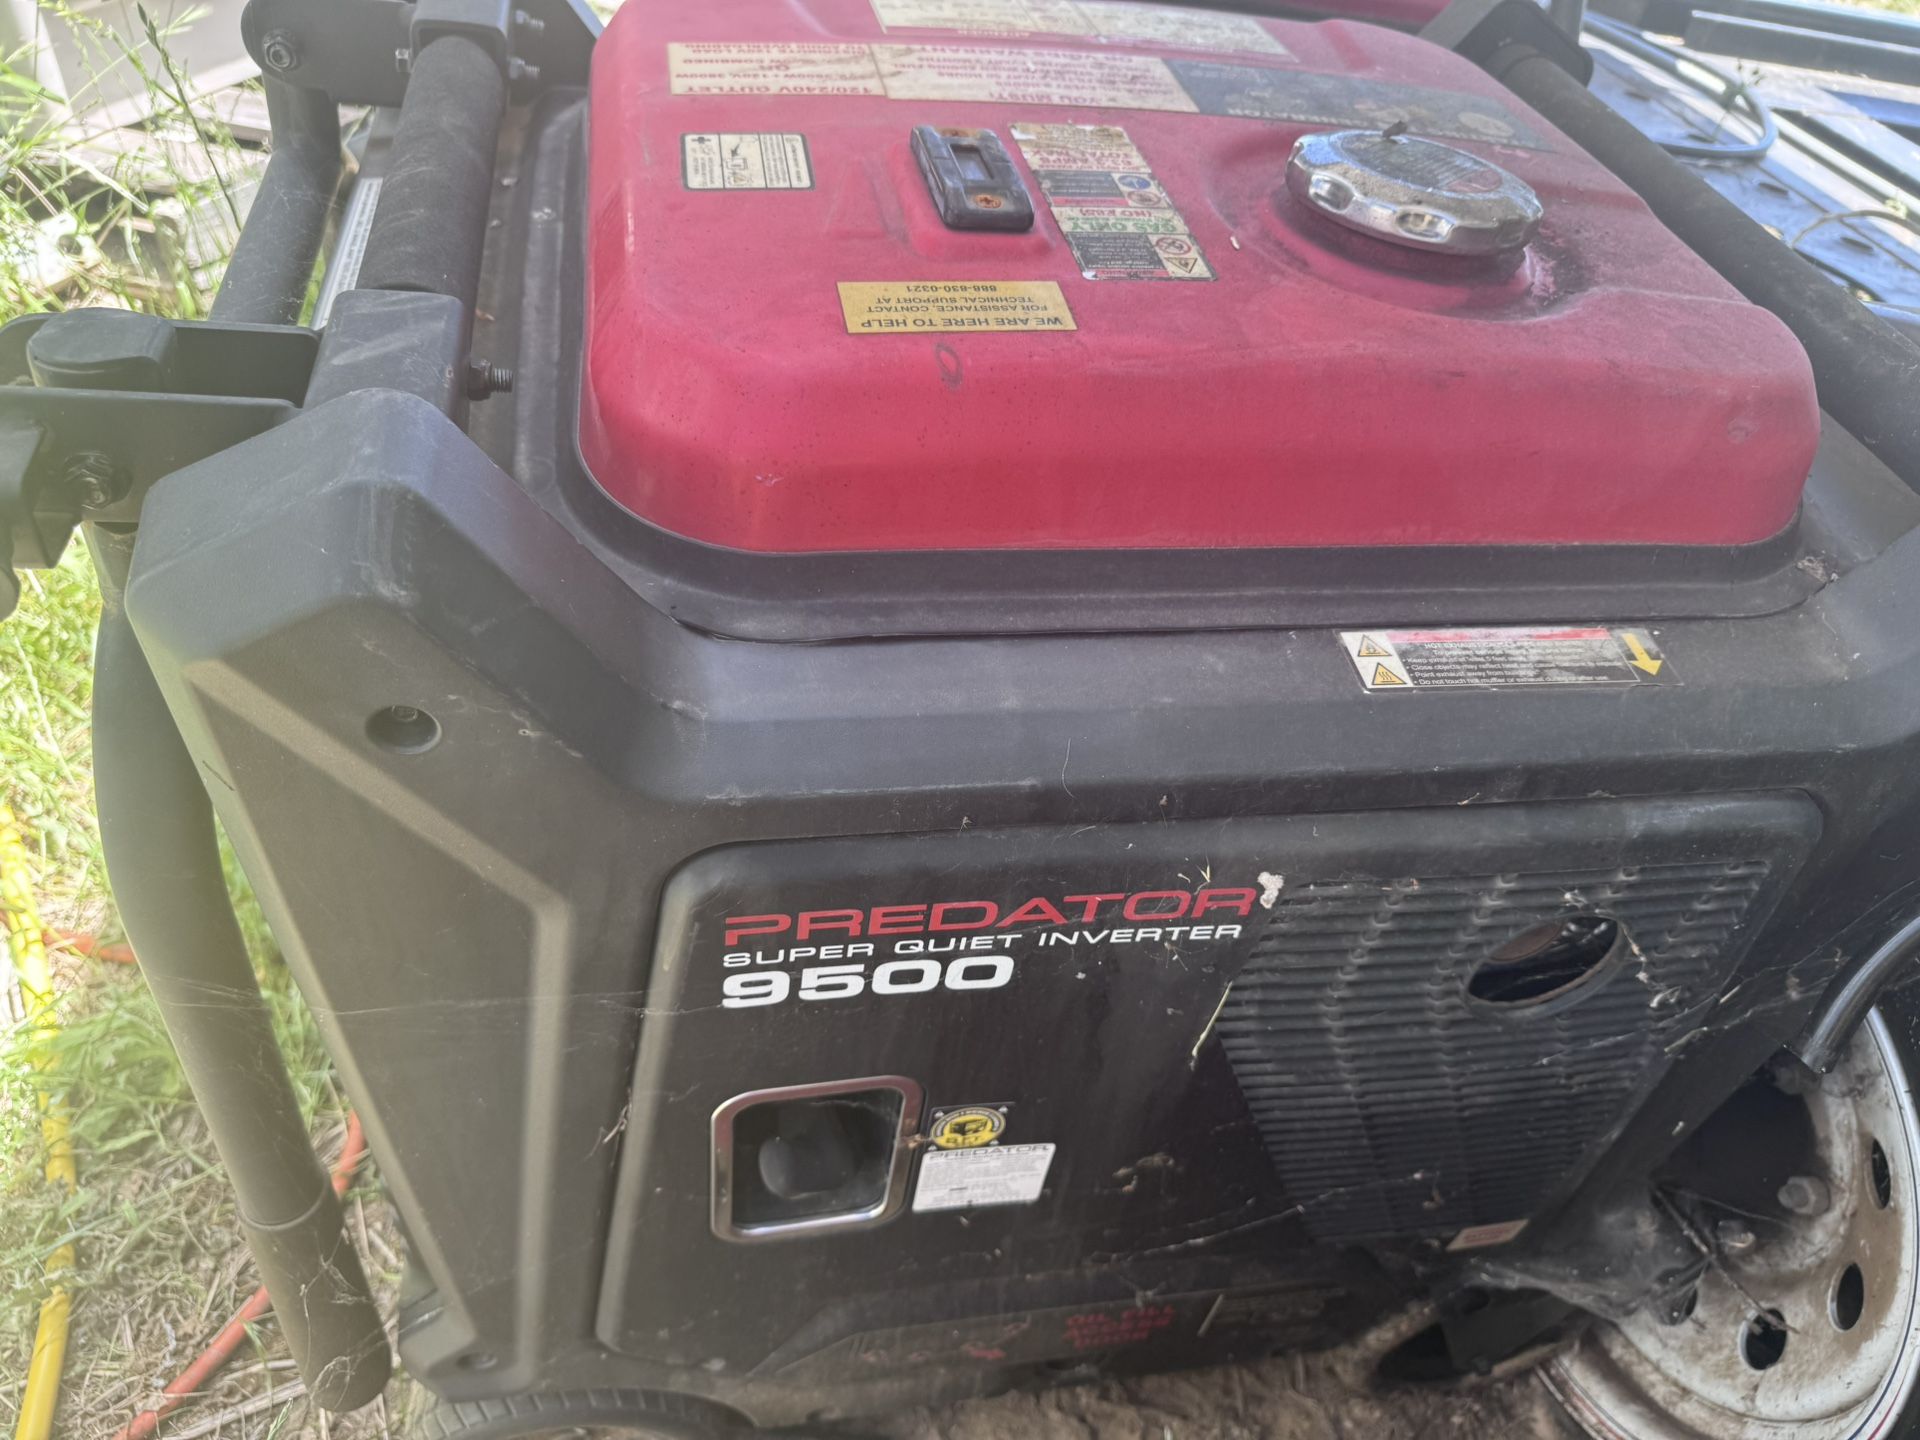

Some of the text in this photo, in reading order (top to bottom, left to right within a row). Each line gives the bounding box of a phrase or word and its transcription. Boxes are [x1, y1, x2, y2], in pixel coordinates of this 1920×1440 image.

[895, 296, 956, 304] SUPPORT
[959, 296, 1033, 304] TECHNICAL
[866, 305, 929, 313] CONTACT
[933, 304, 1018, 312] ASSISTANCE,
[861, 317, 1062, 328] WE ARE HERE TO HELP
[724, 887, 1255, 946] PREDATOR
[722, 923, 1241, 968] SUPER QUIET INVERTER
[721, 955, 1016, 1009] 9500
